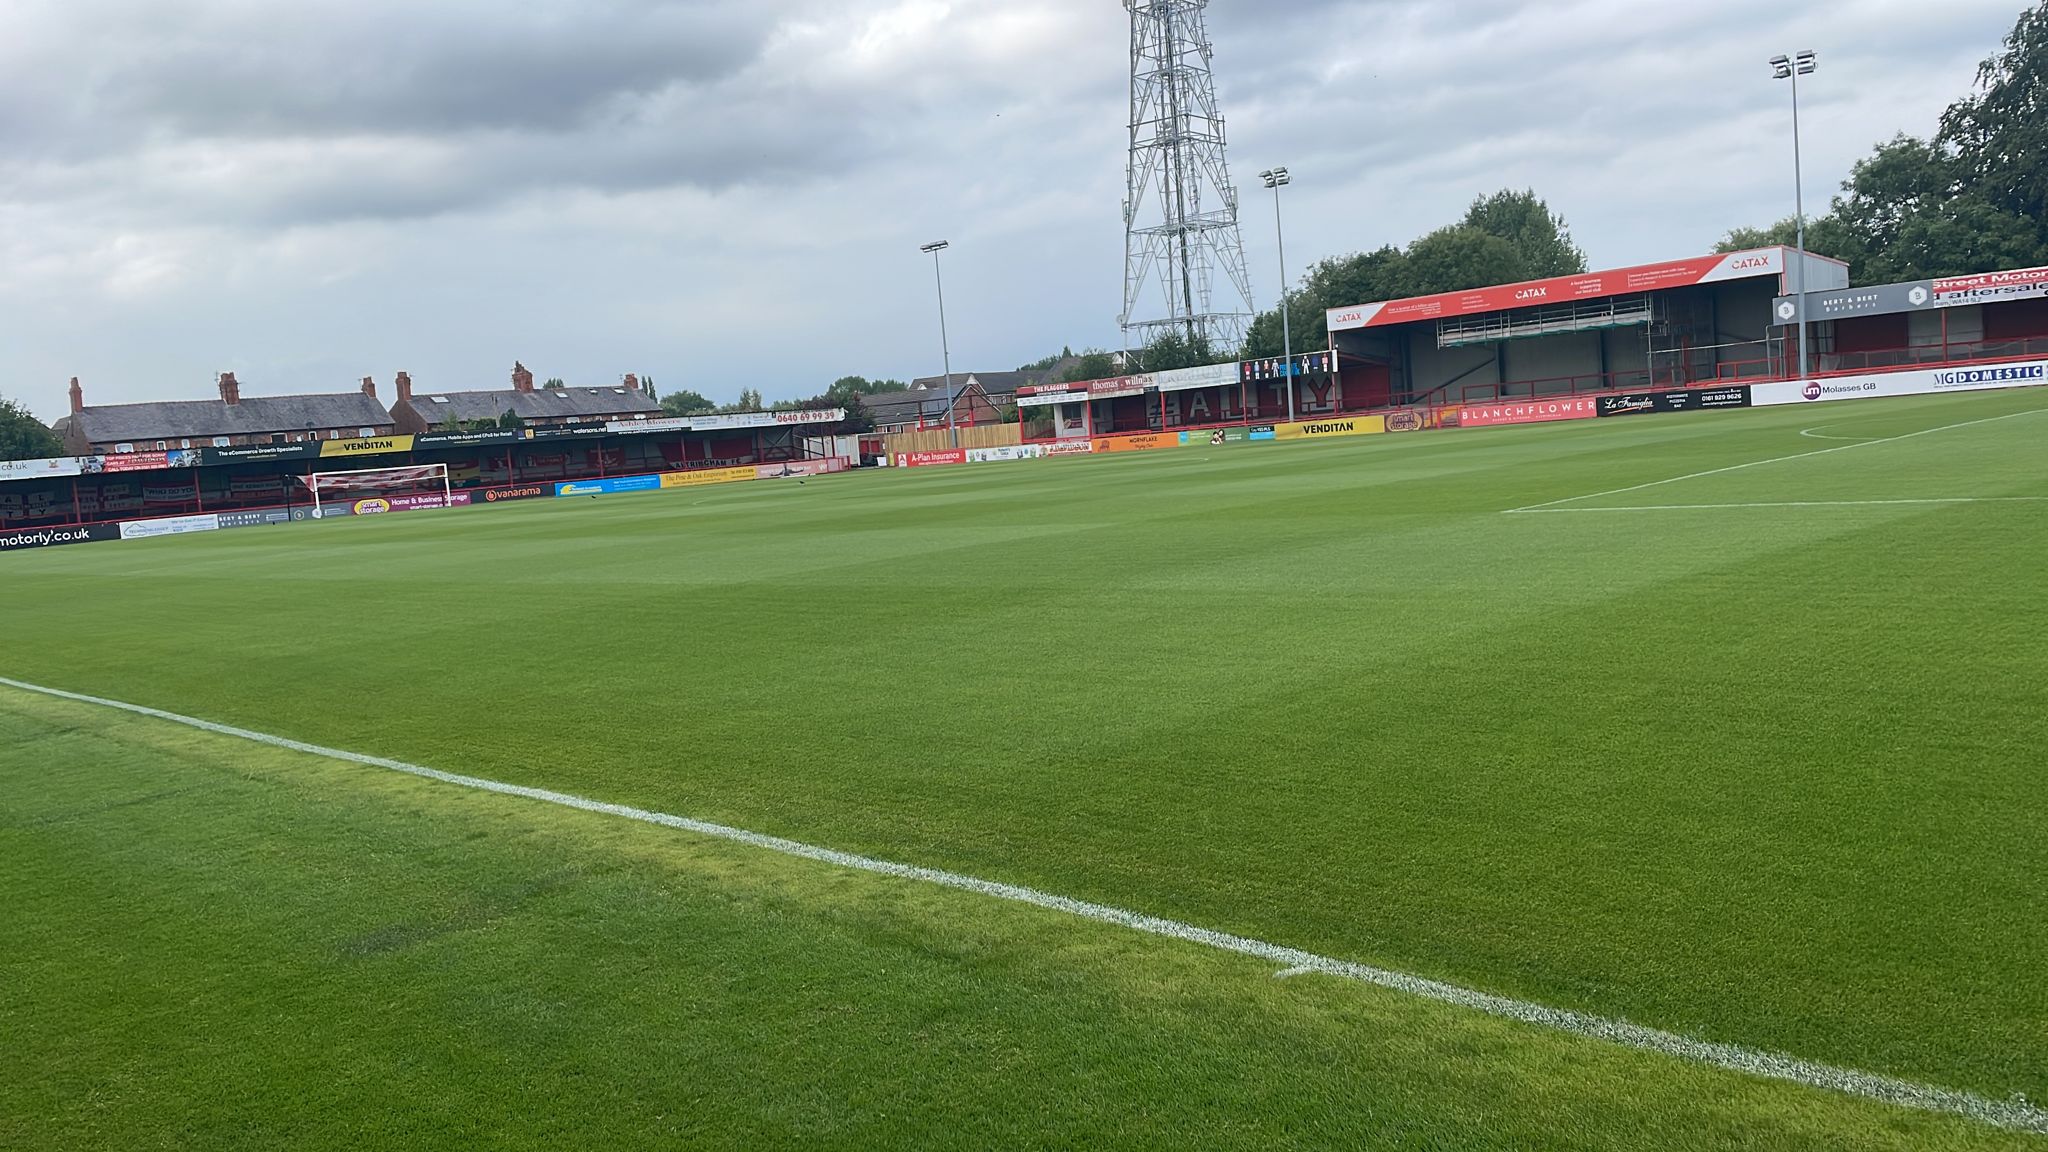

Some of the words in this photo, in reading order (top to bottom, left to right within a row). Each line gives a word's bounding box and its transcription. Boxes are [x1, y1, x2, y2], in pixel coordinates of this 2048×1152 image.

[1731, 256, 1769, 270] CATAX
[1514, 287, 1546, 300] CATAX
[1335, 312, 1361, 323] CATAX
[1934, 372, 1954, 385] MG
[1958, 366, 2041, 383] DOMESTIC
[1092, 380, 1119, 390] thomas
[1822, 386, 1861, 394] Molasses
[1862, 382, 1877, 391] GB
[1462, 401, 1595, 420] BLANCHFLOWER
[776, 414, 798, 423] 0640
[800, 412, 810, 421] 69
[812, 411, 823, 420] 99
[824, 411, 835, 420] 39
[1393, 414, 1413, 422] smart
[1303, 422, 1354, 434] VENDITAN
[1390, 421, 1418, 430] storage
[343, 440, 393, 451] VENDITAN
[911, 453, 931, 461] A-Plan
[931, 451, 960, 460] Insurance
[496, 487, 541, 498] vanarama
